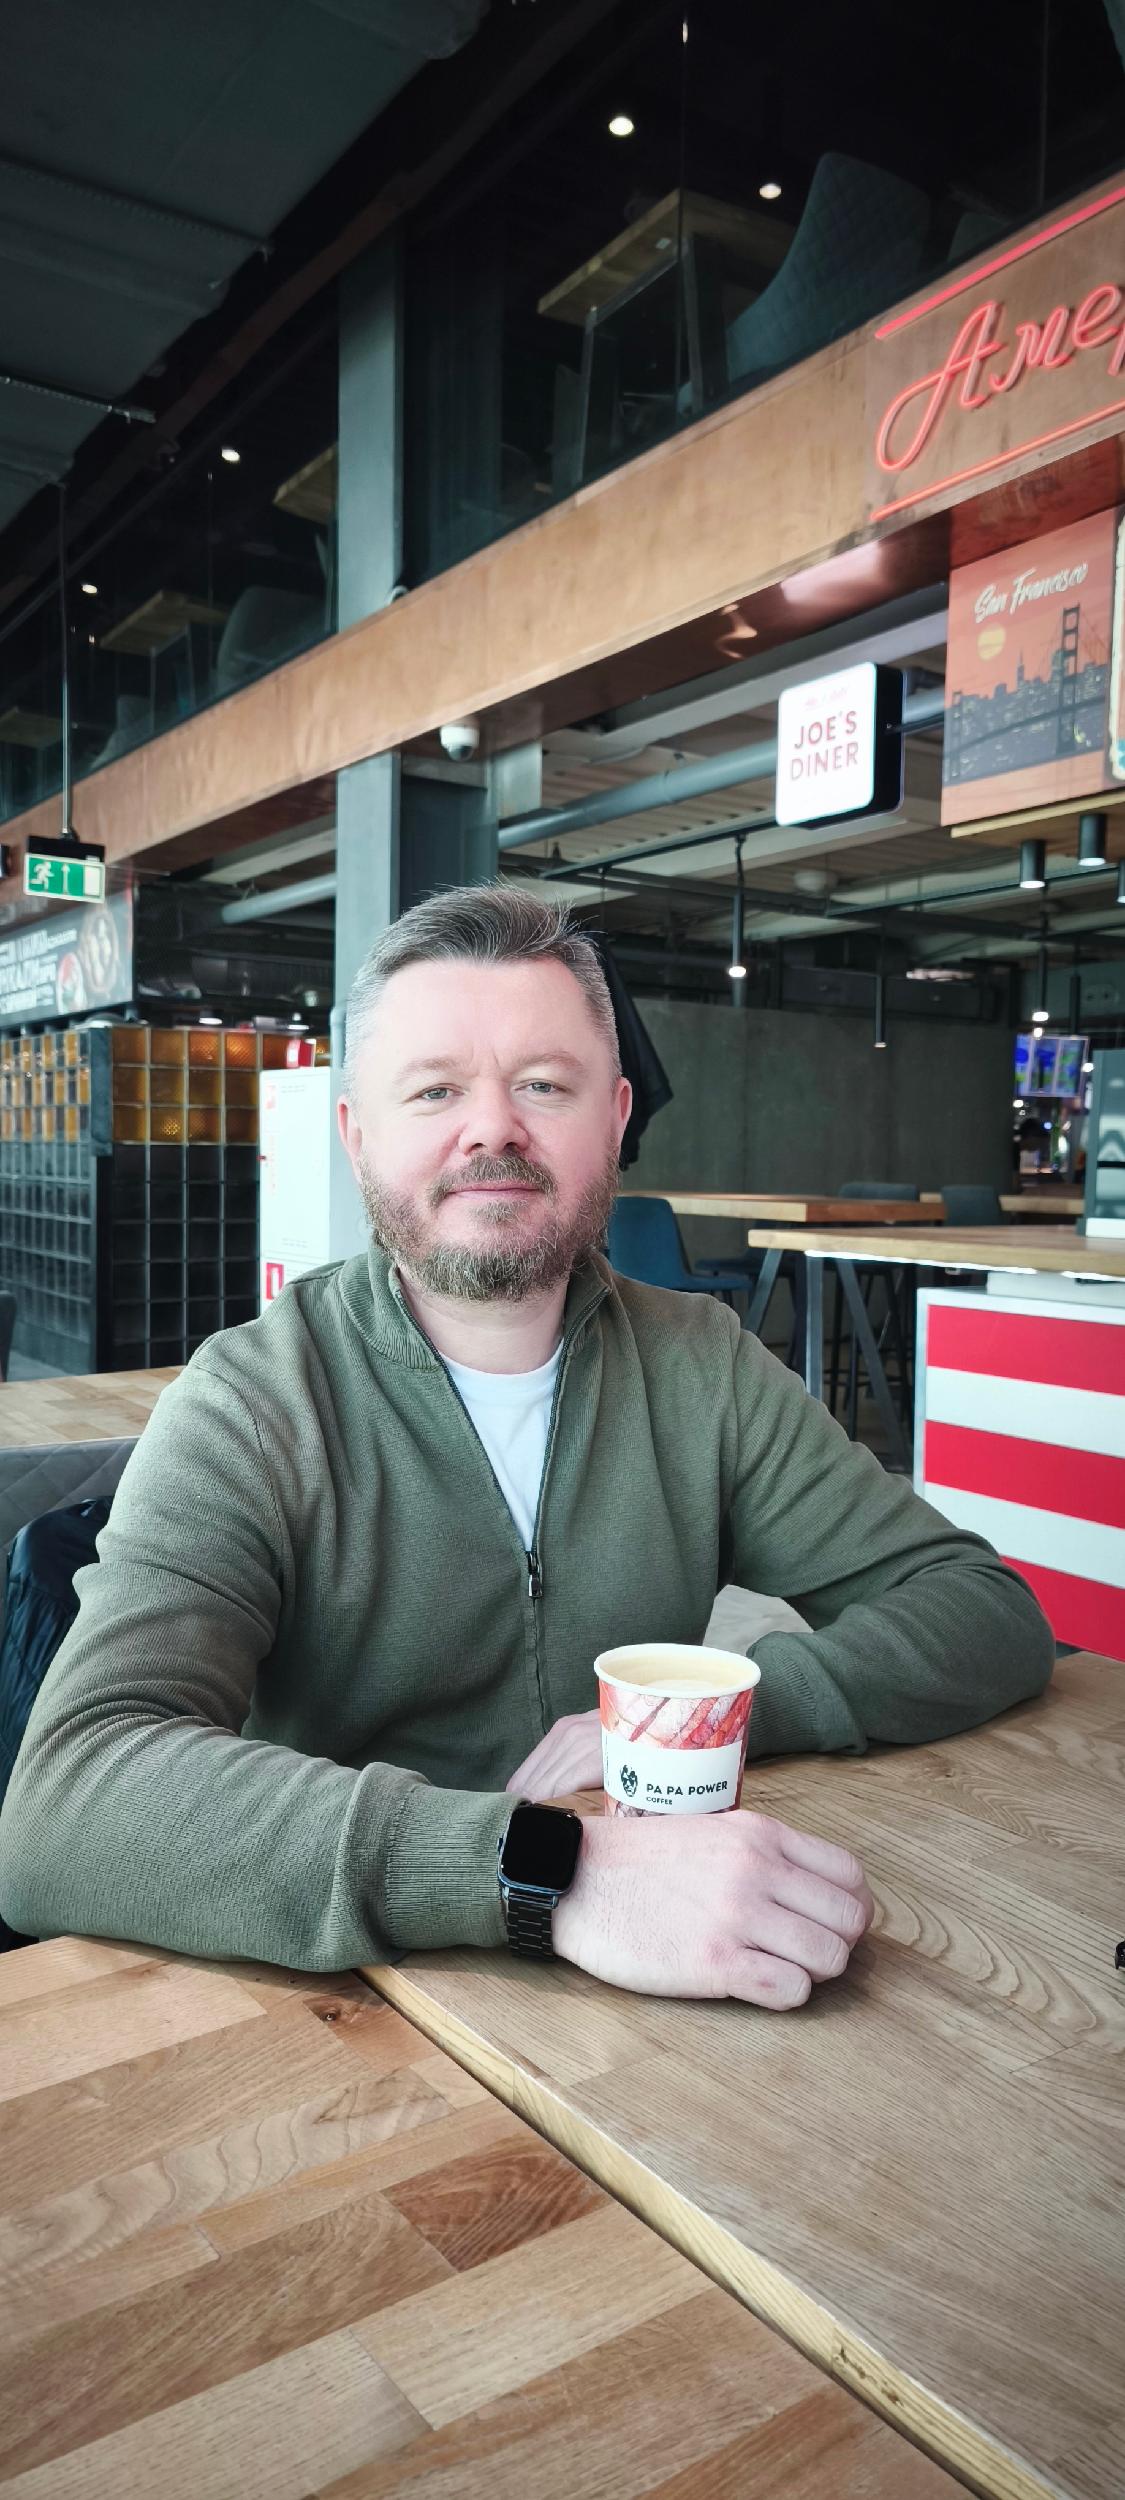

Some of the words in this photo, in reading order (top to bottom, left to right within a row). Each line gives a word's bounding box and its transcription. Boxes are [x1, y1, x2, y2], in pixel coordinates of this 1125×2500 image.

[876, 282, 1125, 472] Аме
[974, 583, 1008, 624] San
[794, 710, 857, 750] JOE'S
[791, 741, 859, 782] DINER
[646, 1783, 662, 1795] PA
[666, 1785, 684, 1796] PA
[688, 1780, 728, 1796] POWER
[646, 1796, 673, 1806] COFFEE
